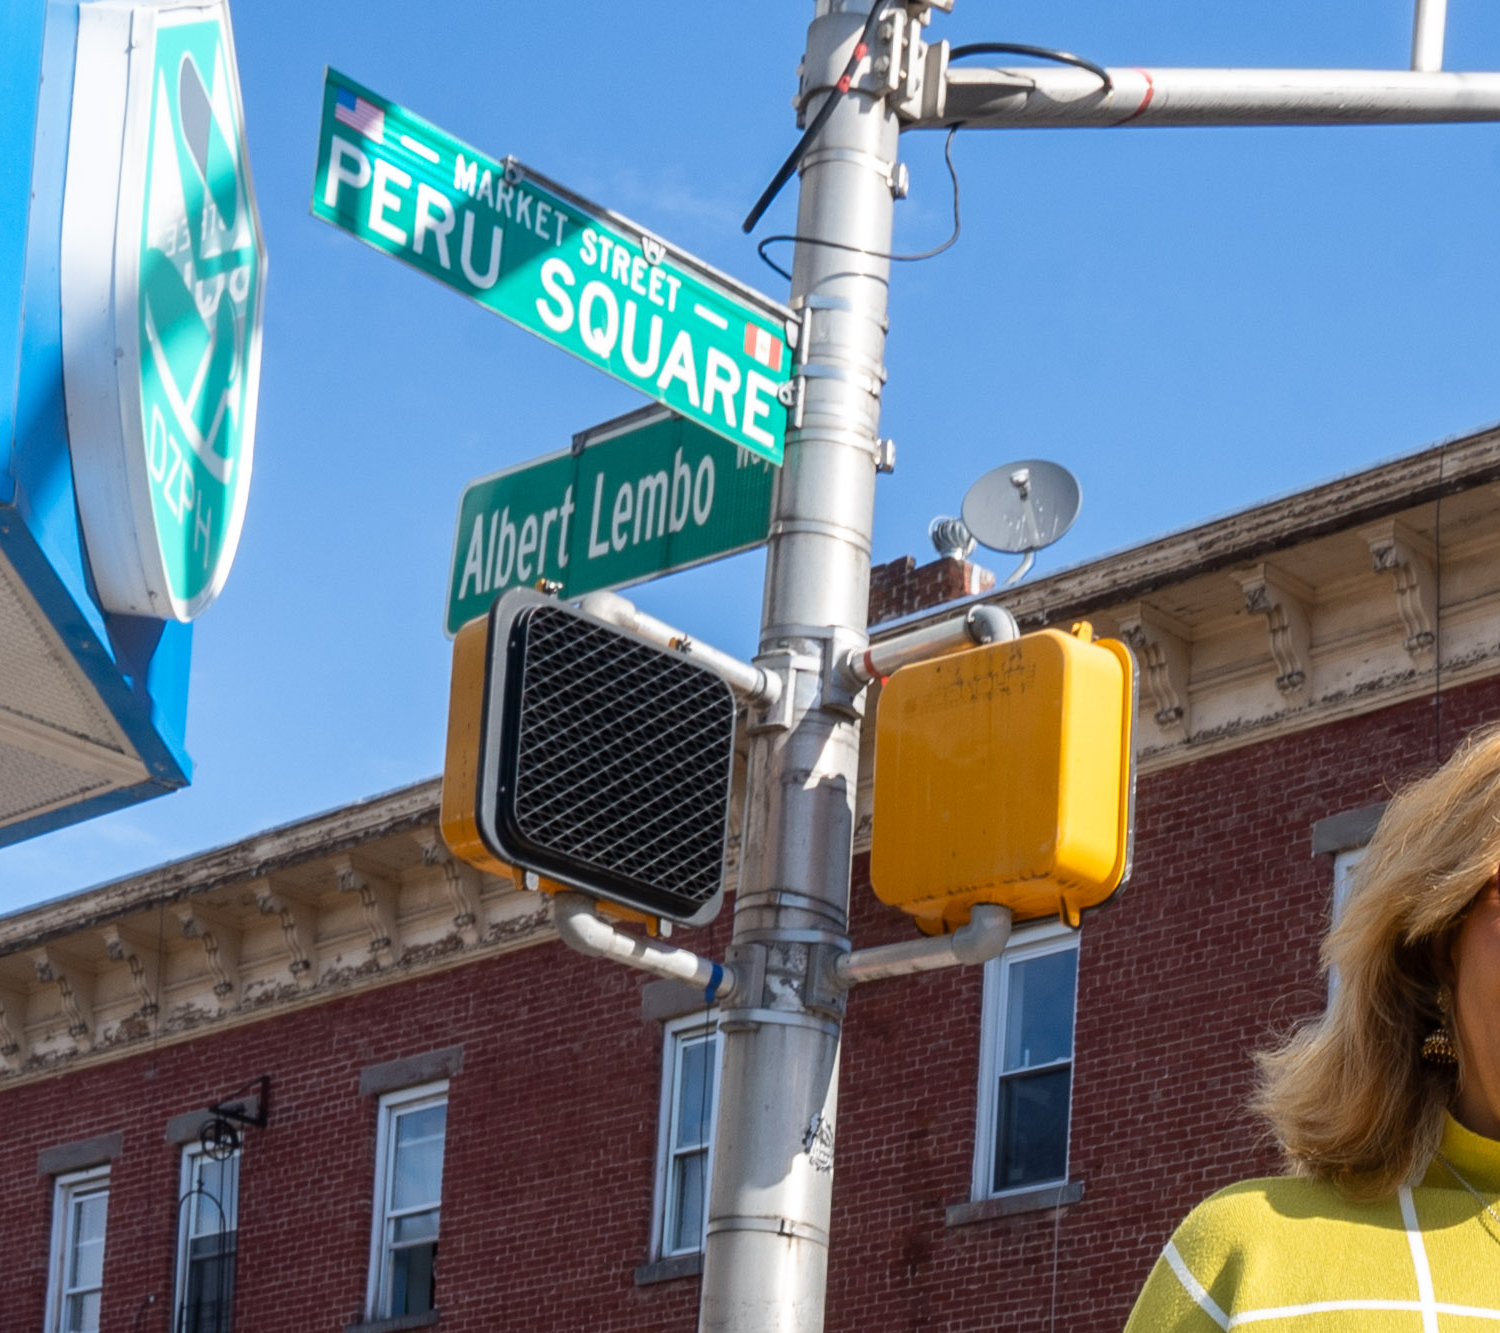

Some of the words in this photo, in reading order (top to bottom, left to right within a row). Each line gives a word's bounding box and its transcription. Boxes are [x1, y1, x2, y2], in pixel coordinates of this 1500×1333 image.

[323, 134, 503, 290] PERU
[535, 257, 779, 449] SQUARE
[453, 153, 569, 248] MARKET
[579, 228, 682, 313] STREET
[458, 484, 576, 601] Albert
[587, 446, 715, 561] Lembo
